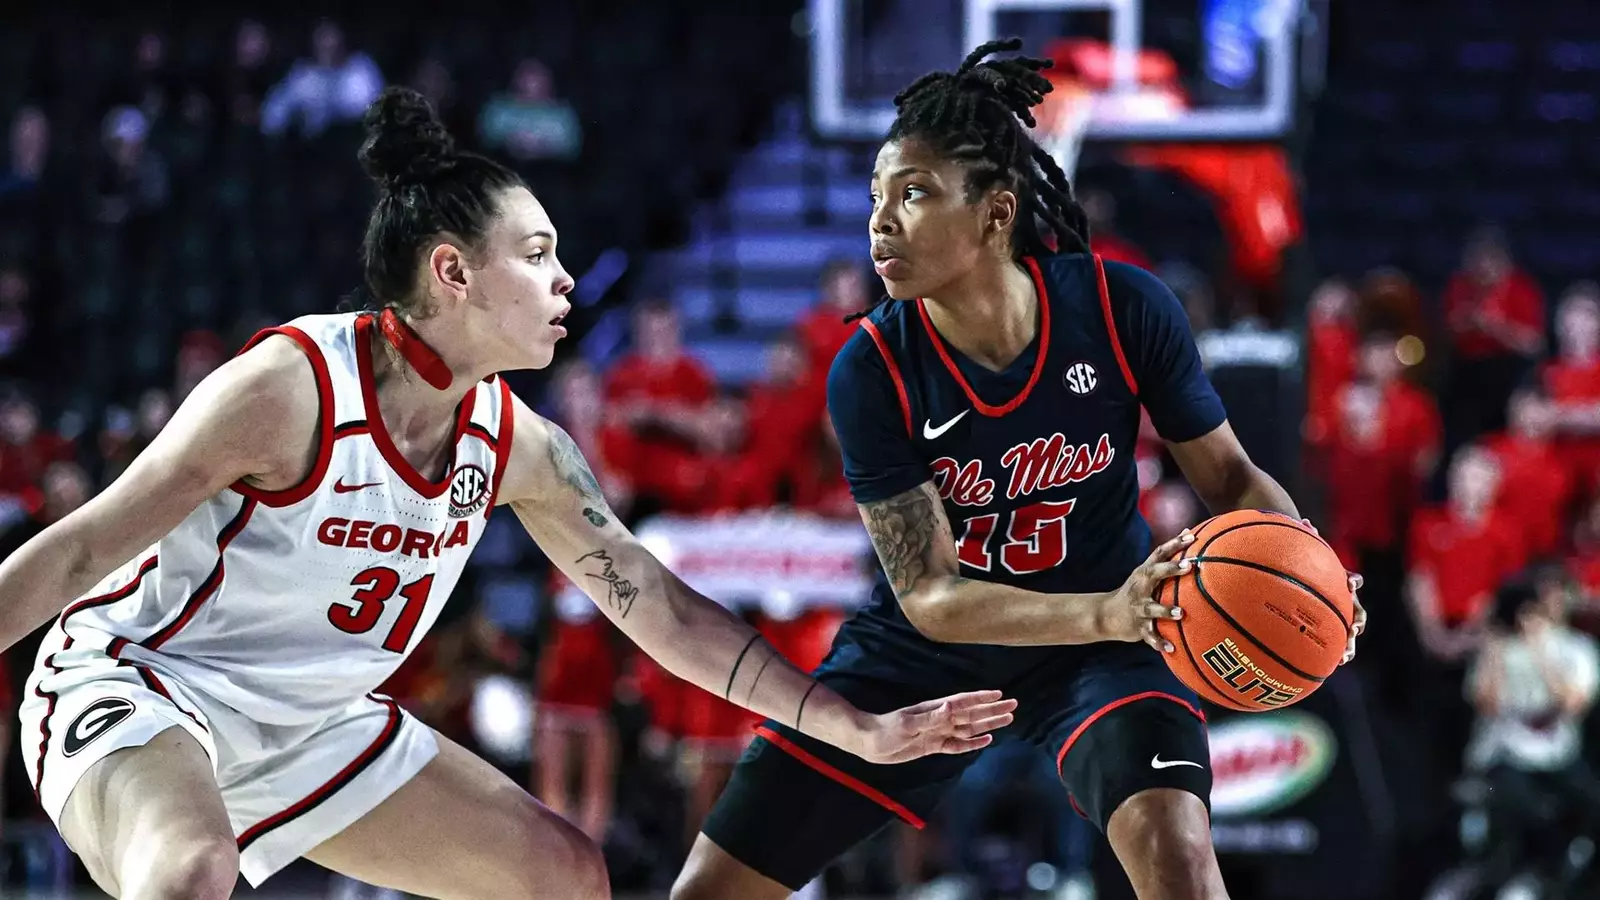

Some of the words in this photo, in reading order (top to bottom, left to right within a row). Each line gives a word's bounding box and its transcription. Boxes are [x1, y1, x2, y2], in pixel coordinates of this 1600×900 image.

[1065, 362, 1098, 395] SEC
[451, 466, 486, 506] SEC
[929, 456, 995, 506] Ole
[1001, 432, 1115, 499] Miss
[448, 489, 492, 518] RADUATE
[317, 517, 469, 559] GEORA
[955, 498, 1077, 575] 15
[327, 566, 436, 654] 31
[1202, 642, 1298, 706] ELITE
[1224, 638, 1304, 694] CHAMPIONSHIP
[62, 696, 136, 758] G
